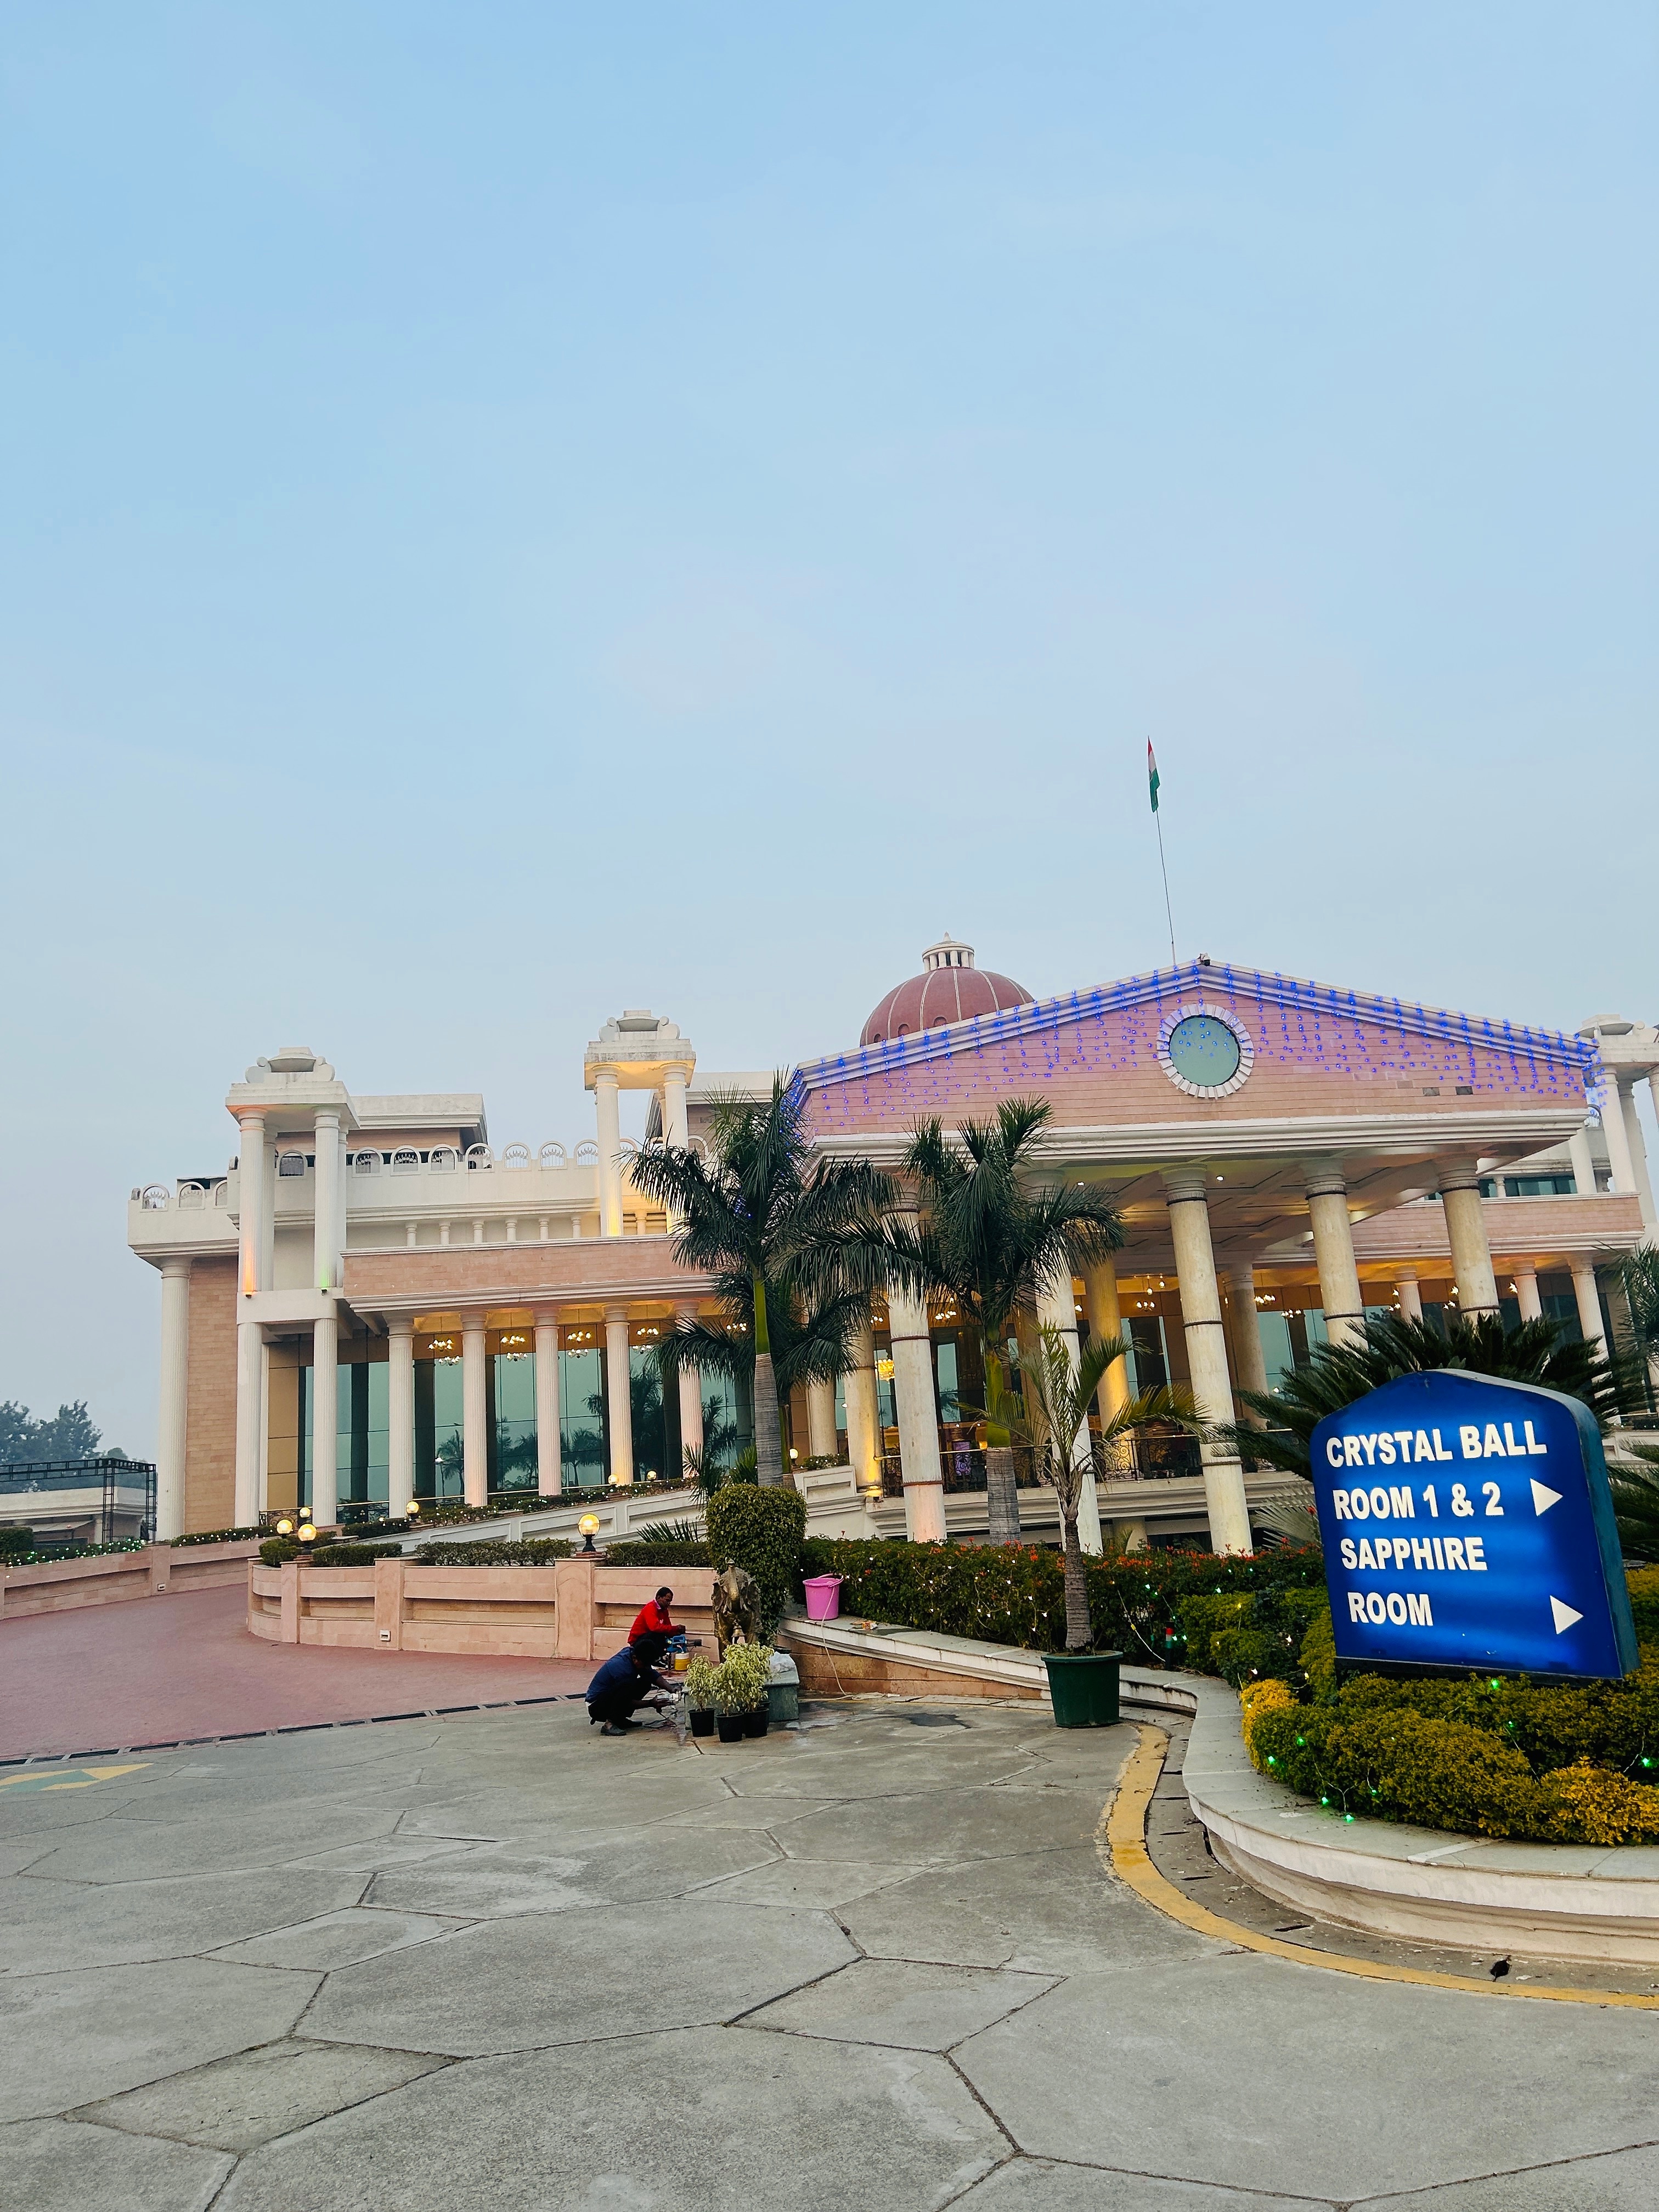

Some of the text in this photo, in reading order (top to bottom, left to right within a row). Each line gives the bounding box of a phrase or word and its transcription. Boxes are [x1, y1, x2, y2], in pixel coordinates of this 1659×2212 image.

[1325, 1420, 1547, 1468] CRYSTAL BALL
[1332, 1482, 1504, 1520] ROOM 1 & 2
[1340, 1537, 1488, 1571] SAPPHIRE
[1347, 1592, 1434, 1626] ROOM
